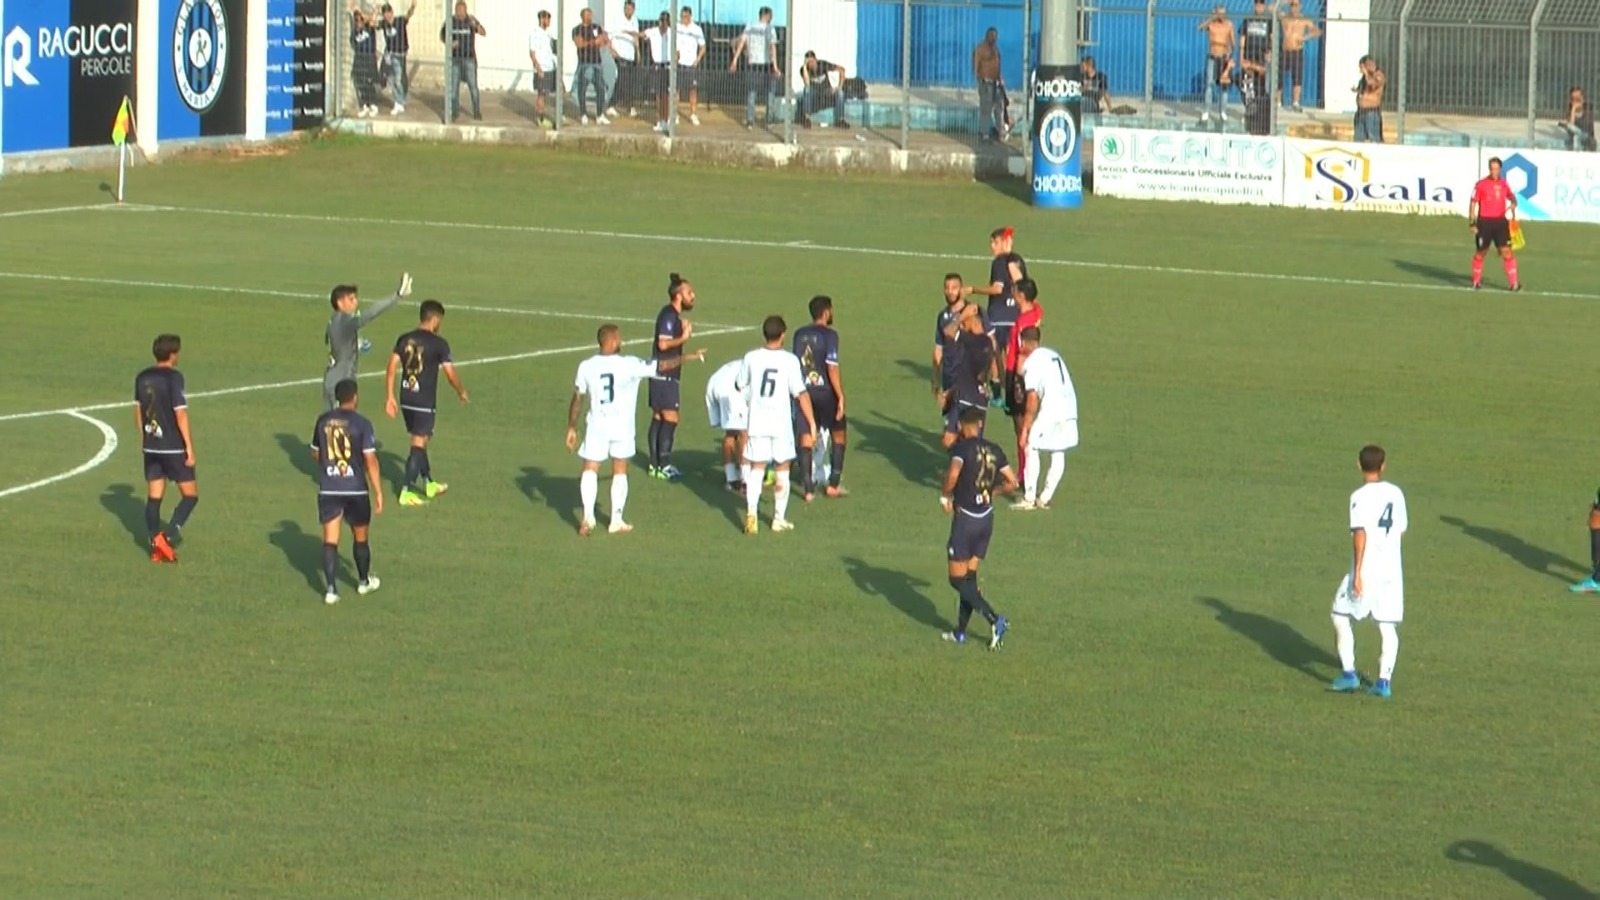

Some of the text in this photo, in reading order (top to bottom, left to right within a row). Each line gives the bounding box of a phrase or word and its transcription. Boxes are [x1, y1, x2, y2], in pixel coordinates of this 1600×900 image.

[39, 22, 132, 57] RAGUCCI
[81, 56, 131, 76] PERGOLE
[1132, 165, 1196, 177] Concessionaria
[1198, 169, 1232, 180] Ufficiale
[1234, 171, 1272, 181] Esclusiva
[1316, 155, 1454, 203] Scala
[759, 368, 778, 398] 6
[1051, 357, 1065, 385] 7
[600, 372, 615, 404] 3
[324, 426, 352, 461] 10
[975, 452, 997, 489] 25
[1377, 502, 1394, 536] 4
